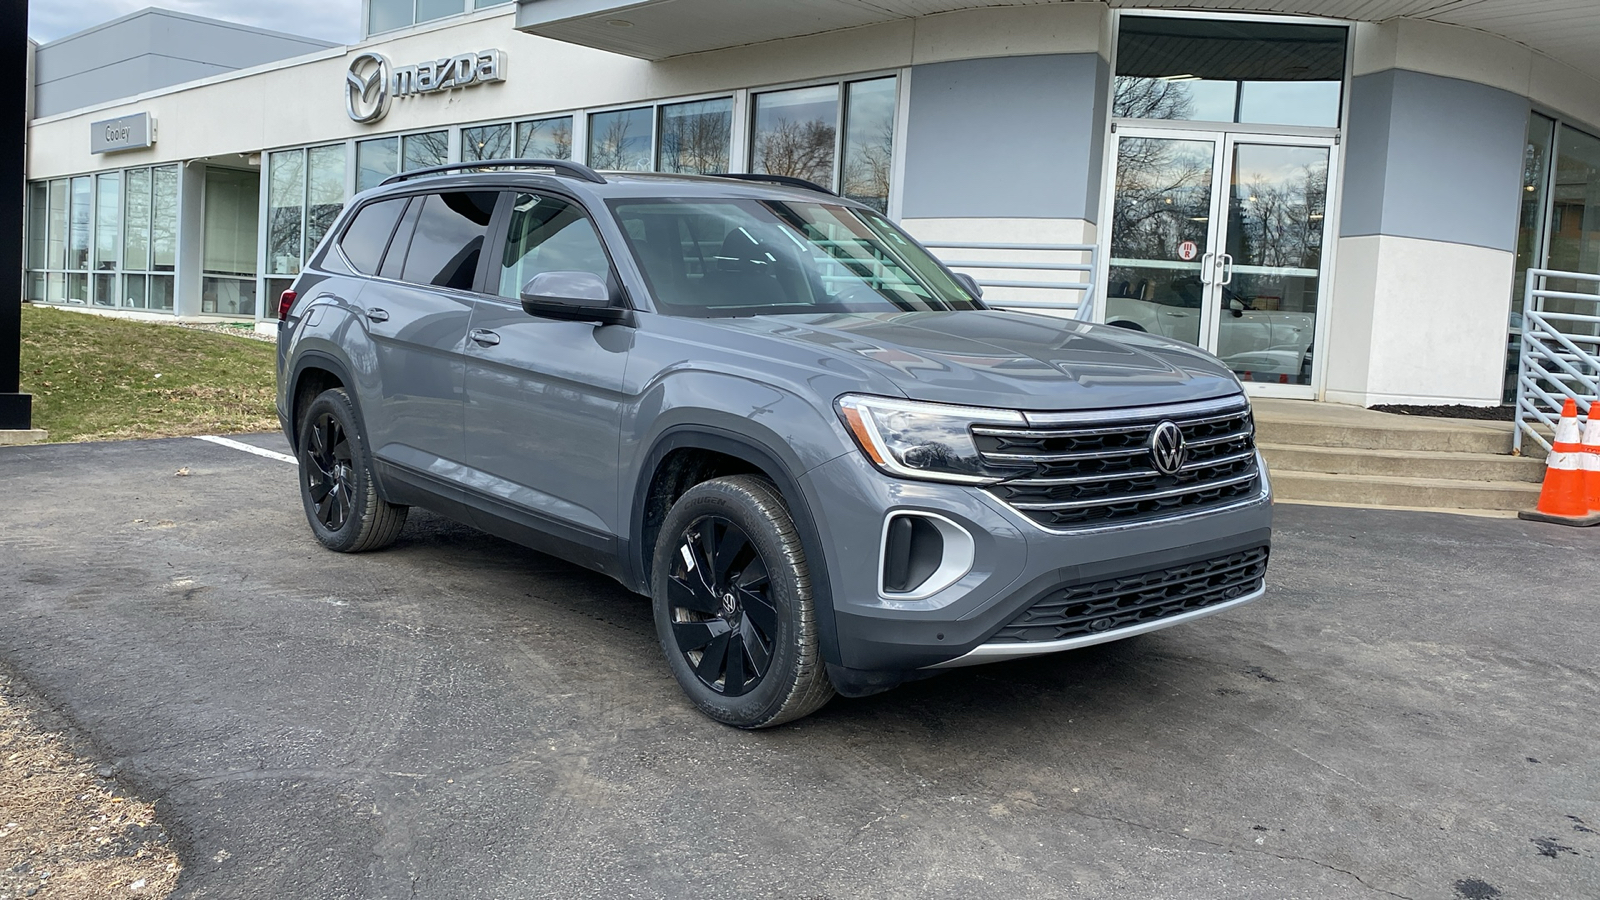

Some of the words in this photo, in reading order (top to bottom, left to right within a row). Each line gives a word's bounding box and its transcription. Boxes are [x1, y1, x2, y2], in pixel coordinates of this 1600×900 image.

[105, 121, 130, 144] Cooley
[1184, 250, 1190, 258] R
[684, 496, 727, 511] CRUGEN
